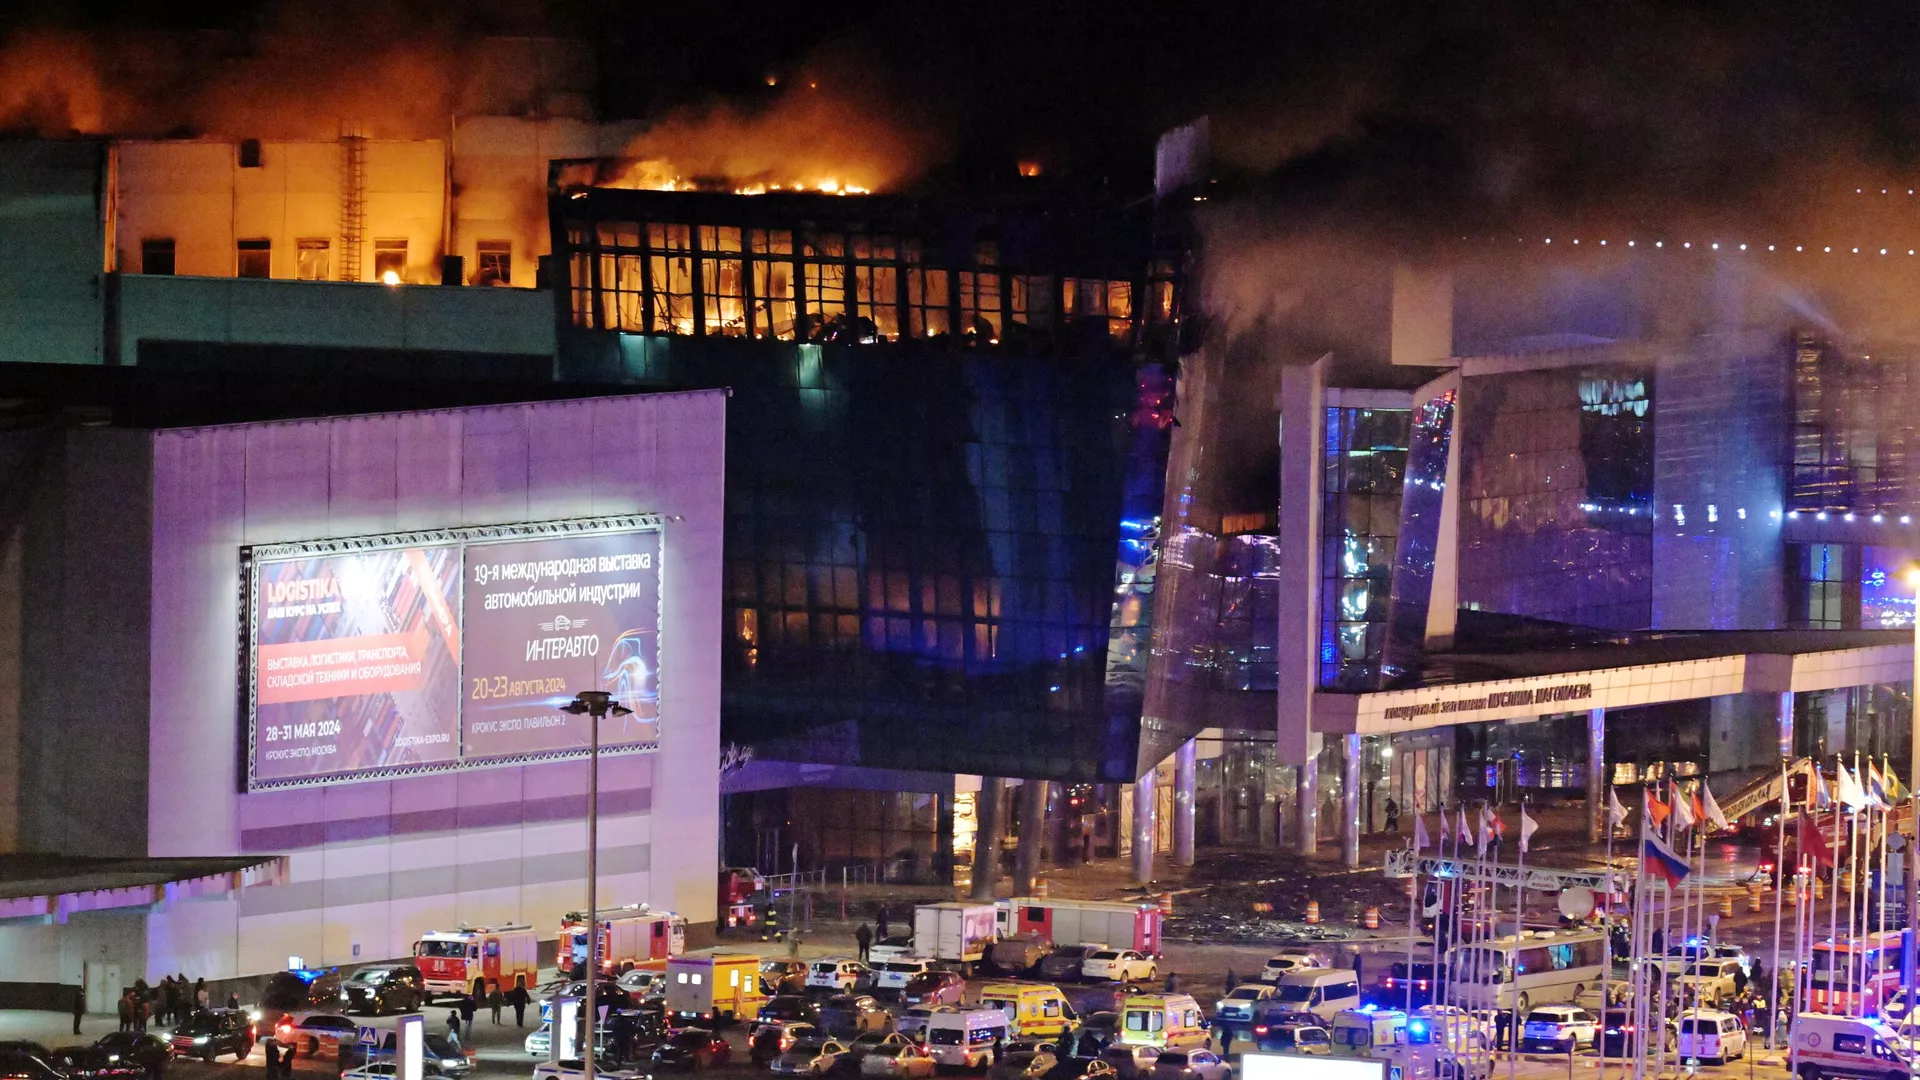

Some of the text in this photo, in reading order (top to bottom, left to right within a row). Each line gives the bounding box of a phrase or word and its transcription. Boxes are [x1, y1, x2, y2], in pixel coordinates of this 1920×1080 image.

[475, 551, 651, 586] 19-я международная выставка
[267, 577, 338, 602] LOGISTIKA
[484, 582, 640, 610] автомобильной индустрии
[267, 656, 308, 670] ВЫСТАВКА
[357, 646, 409, 661] ТРАНСПОРТА,
[526, 634, 599, 662] ИНТЕРАВТО
[267, 662, 421, 688] СКЛАДСКОЙ ТЕХНИКИ И ОБОРУДОВАНИЯ
[472, 676, 566, 700] 20-23 АВГУСТА 2024
[1488, 689, 1534, 709] МУСЛИМА
[1535, 683, 1592, 704] МАГОМАЕВА
[294, 722, 316, 739] МАЯ
[317, 719, 341, 737] 2024
[471, 718, 498, 734] КРОКУС
[523, 714, 560, 731] ПАВИЛЬОН
[560, 714, 566, 726] 2
[265, 748, 289, 761] КРОКУС
[312, 744, 337, 756] МОСКВА
